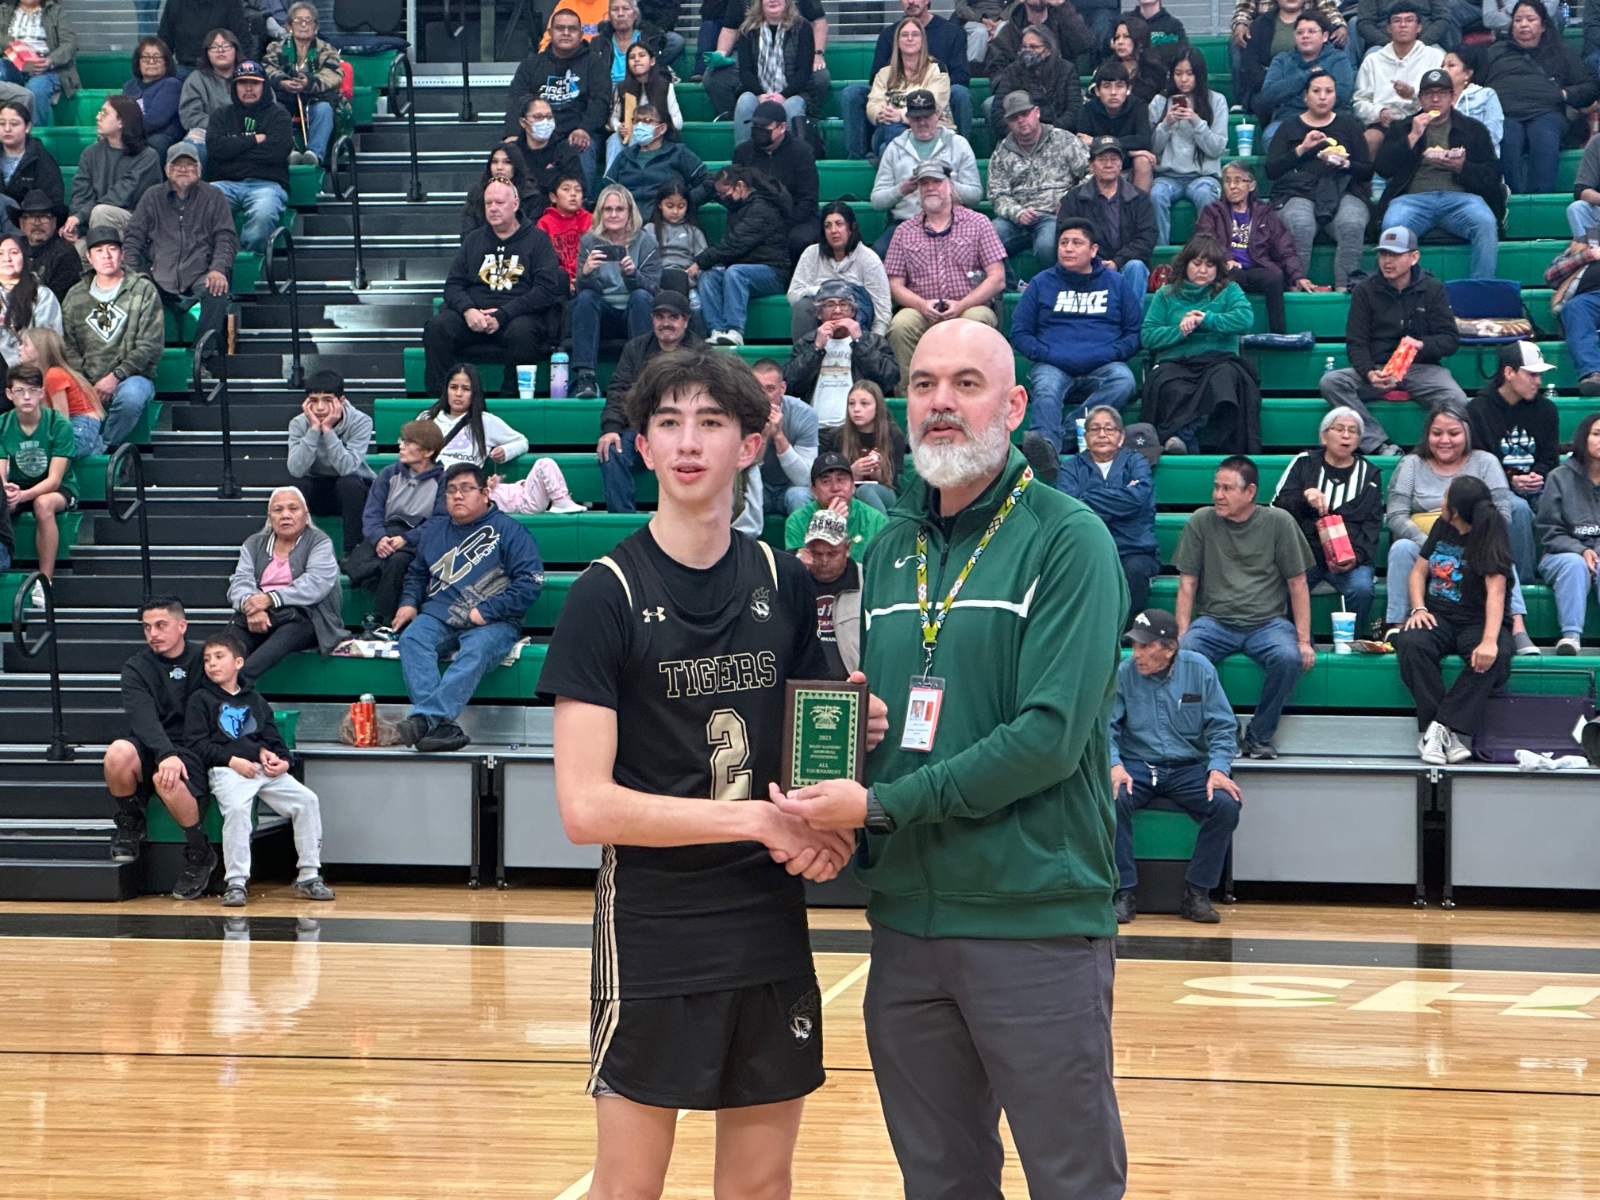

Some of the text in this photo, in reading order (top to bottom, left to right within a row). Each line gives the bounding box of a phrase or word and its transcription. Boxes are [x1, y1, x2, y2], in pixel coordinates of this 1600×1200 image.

[1053, 289, 1108, 314] NIKE
[812, 519, 838, 531] ARMY
[659, 650, 778, 698] TIGERS
[706, 708, 753, 801] 2
